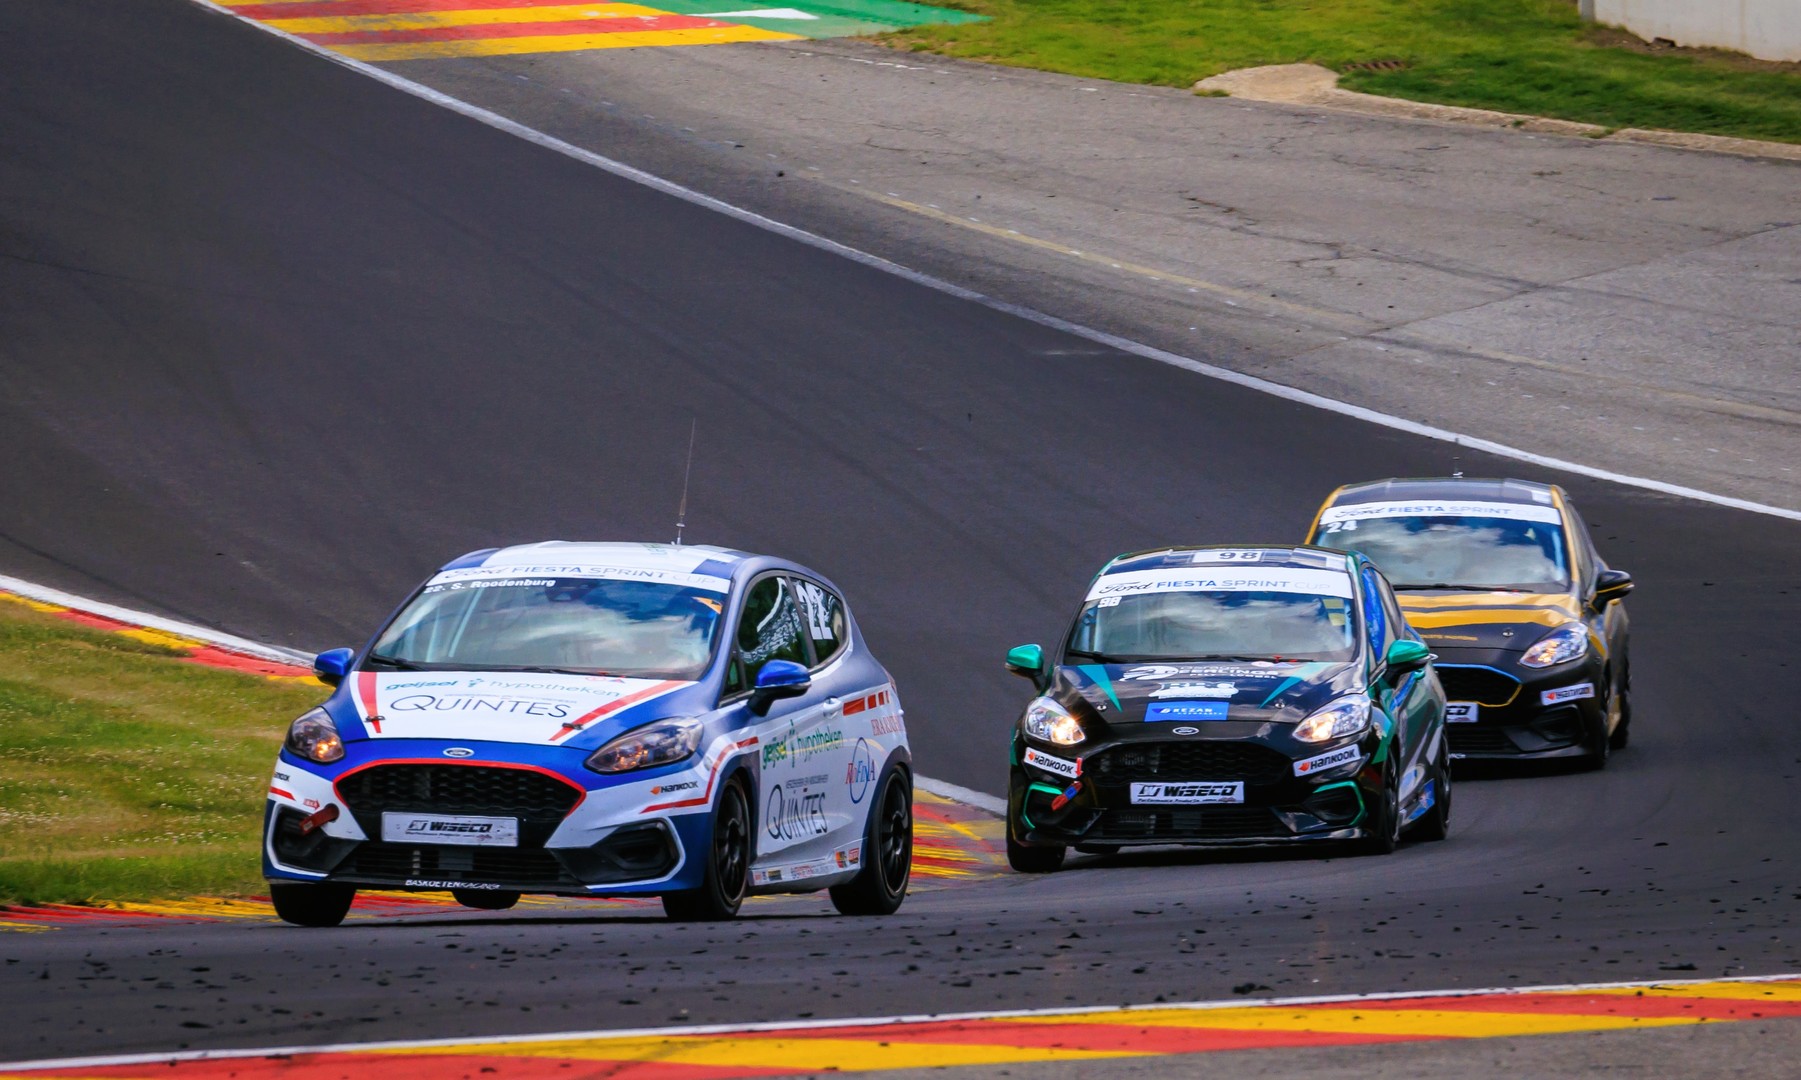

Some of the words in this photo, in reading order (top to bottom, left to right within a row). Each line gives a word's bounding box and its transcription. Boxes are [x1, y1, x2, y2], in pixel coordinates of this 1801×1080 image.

[1387, 505, 1446, 513] FIESTA
[1449, 506, 1511, 515] SPRINT
[1327, 520, 1358, 533] 24
[1219, 552, 1258, 560] 98
[587, 566, 668, 579] SPRINT
[451, 582, 466, 590] S.
[470, 579, 556, 588] Roodenburg
[1098, 581, 1152, 594] Ford
[1155, 579, 1218, 588] FIESTA
[1222, 580, 1291, 588] SPRINT
[1293, 582, 1331, 590] CUP
[1098, 597, 1121, 608] 98
[385, 680, 458, 691] geijsel
[489, 679, 621, 697] hypotheken
[796, 726, 844, 763] hypotheken
